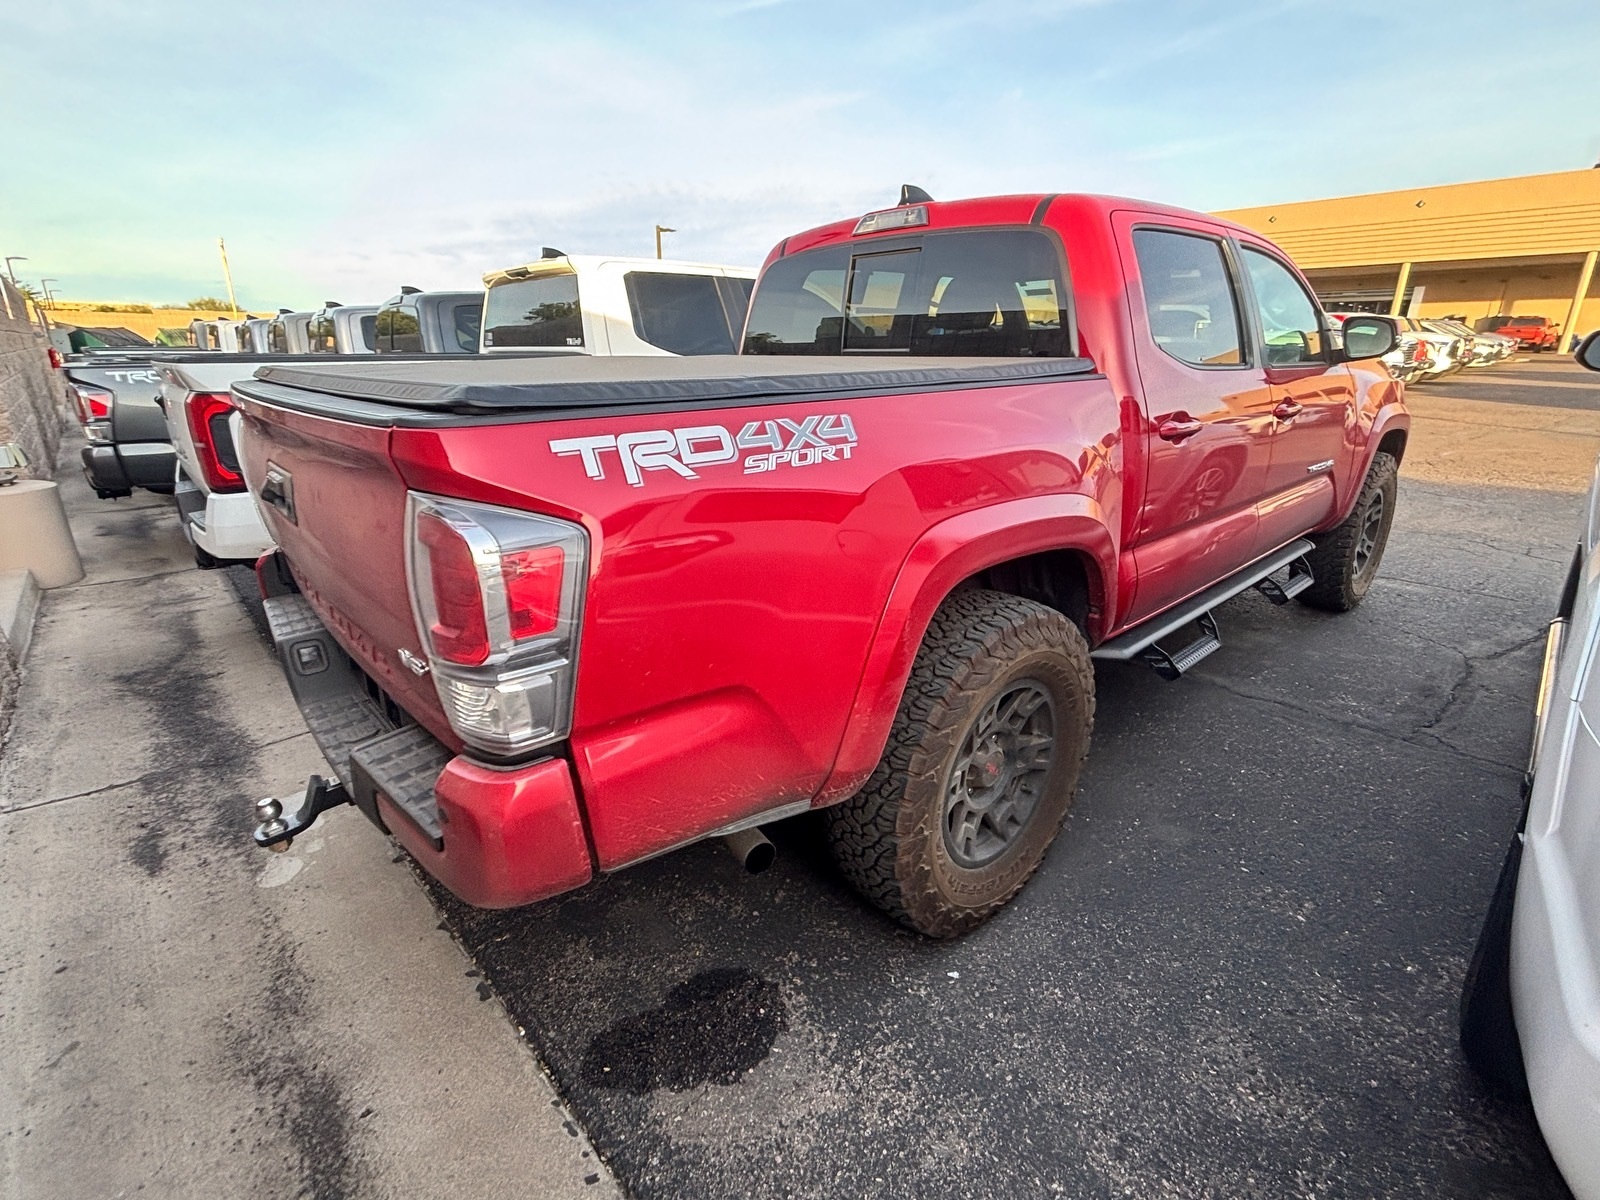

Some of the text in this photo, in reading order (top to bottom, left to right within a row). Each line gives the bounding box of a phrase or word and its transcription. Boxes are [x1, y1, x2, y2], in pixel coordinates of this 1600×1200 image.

[548, 413, 858, 487] TRD 4X4
[743, 442, 858, 475] SPORT
